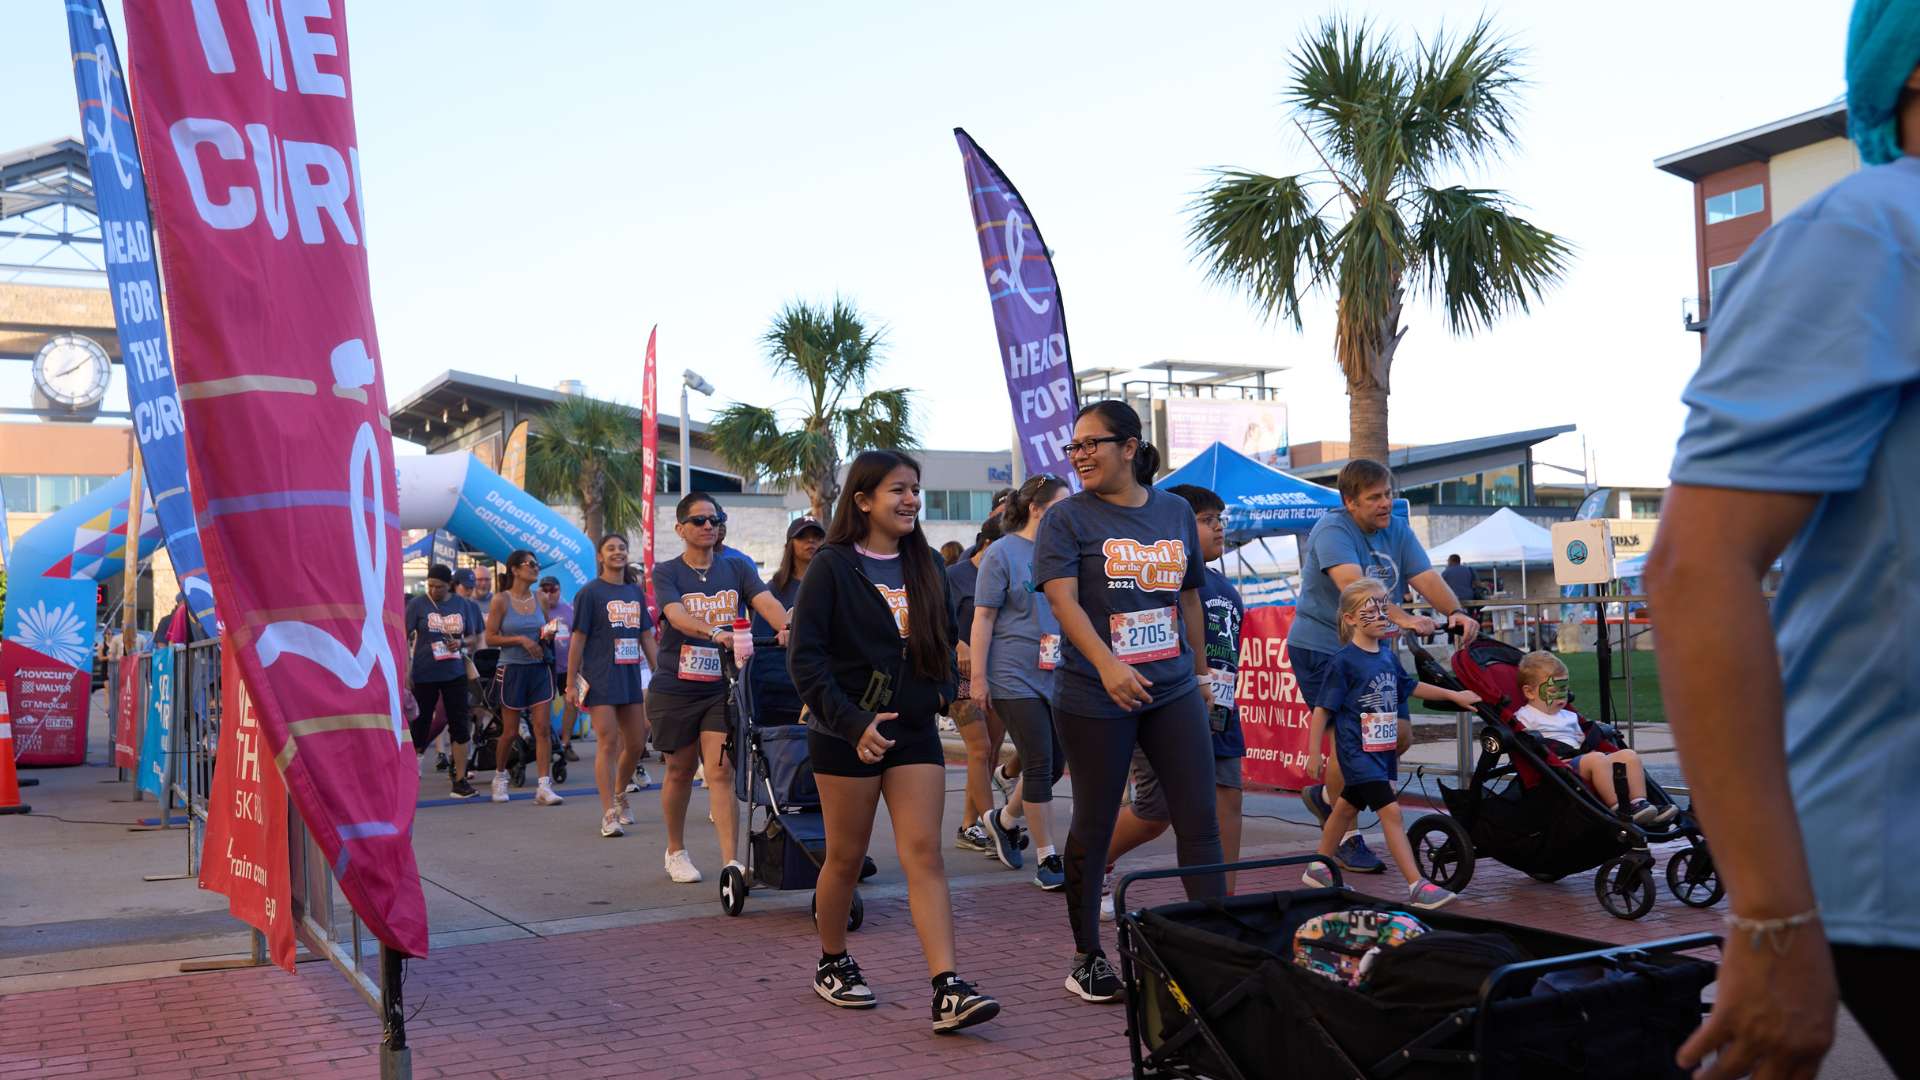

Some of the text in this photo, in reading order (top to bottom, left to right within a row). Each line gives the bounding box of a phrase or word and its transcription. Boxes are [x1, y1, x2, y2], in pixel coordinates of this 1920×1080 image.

[169, 117, 368, 248] CUR
[119, 279, 158, 325] FOR
[129, 337, 170, 384] THE
[1009, 332, 1067, 379] HEAD
[1021, 377, 1071, 425] FOR
[135, 393, 185, 445] CUR
[1029, 422, 1073, 467] TH
[485, 490, 582, 555] Defeating brain
[1249, 510, 1272, 520] HEAD
[1273, 510, 1290, 520] FOR
[1291, 509, 1306, 519] THE
[474, 506, 520, 537] cancer
[519, 531, 551, 554] step
[549, 545, 569, 562] by
[1110, 543, 1170, 564] Head
[1112, 562, 1141, 572] for the
[1107, 581, 1135, 590] 2024
[1128, 624, 1167, 647] 2705
[690, 656, 720, 672] 2798
[1238, 637, 1292, 669] AD FO
[20, 700, 68, 710] GT Medical
[1245, 747, 1279, 761] ancer
[1295, 750, 1310, 770] by
[235, 790, 253, 820] 5K
